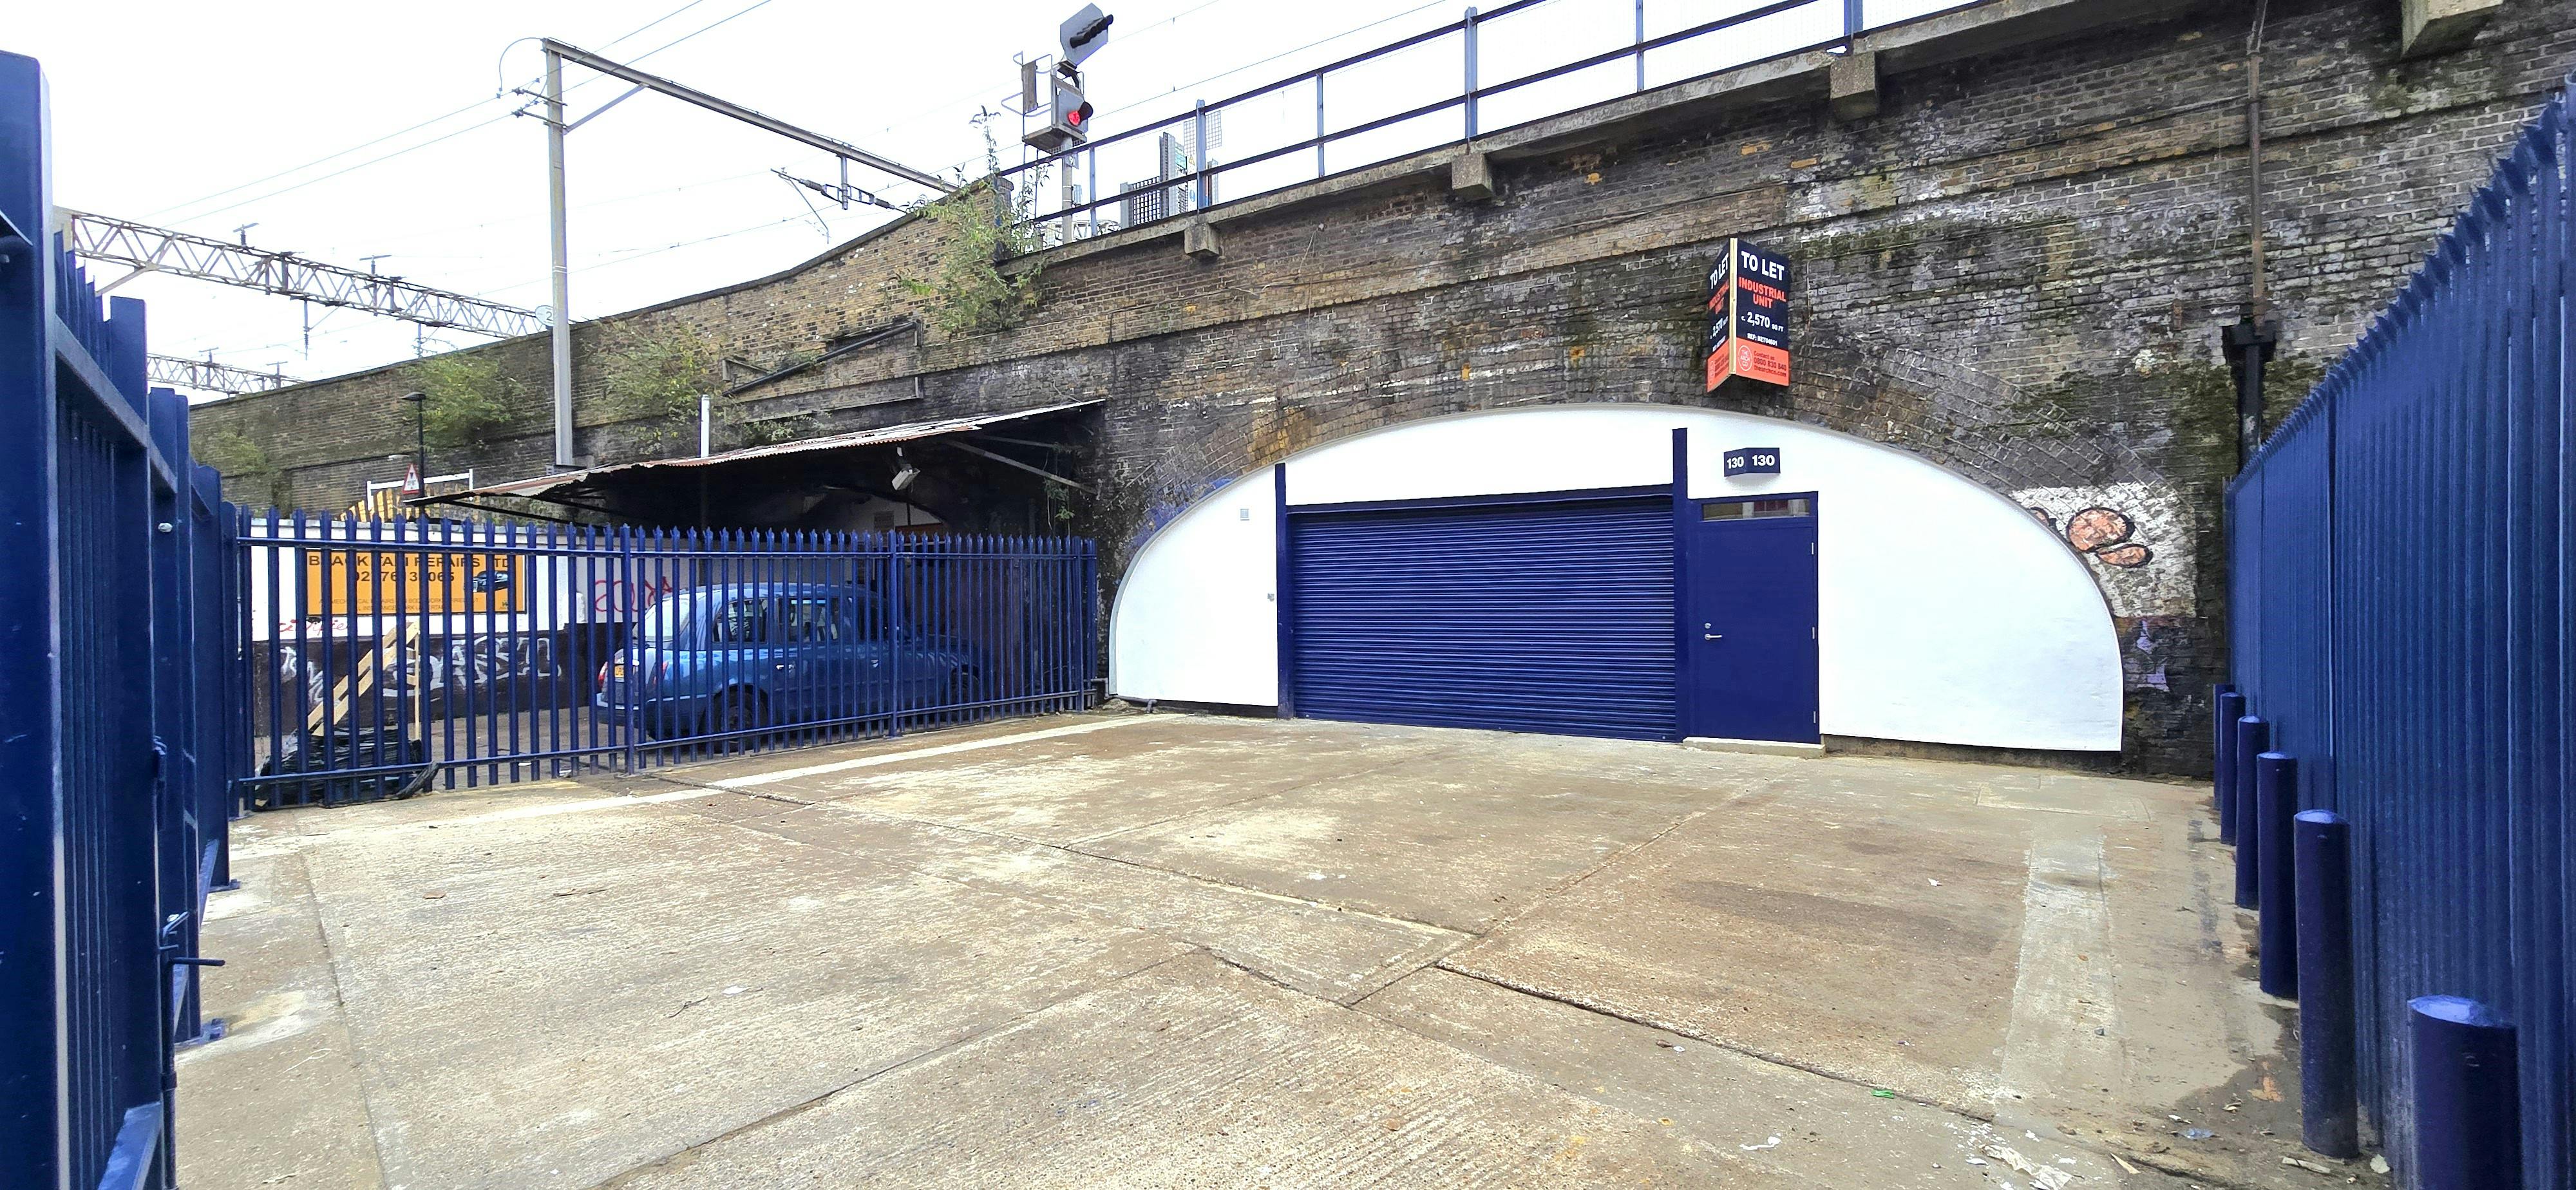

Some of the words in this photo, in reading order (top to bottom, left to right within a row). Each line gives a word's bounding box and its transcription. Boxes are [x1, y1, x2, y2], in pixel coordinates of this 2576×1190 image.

[1718, 252, 1729, 279] LET
[1741, 250, 1758, 272] TO
[1761, 258, 1785, 281] LET
[1738, 276, 1786, 303] INDUSTRIAL
[1752, 293, 1773, 308] UNIT
[1747, 311, 1770, 328] 2,570
[1727, 456, 1744, 469] 130
[1752, 455, 1776, 466] 130
[308, 555, 368, 567] BAK
